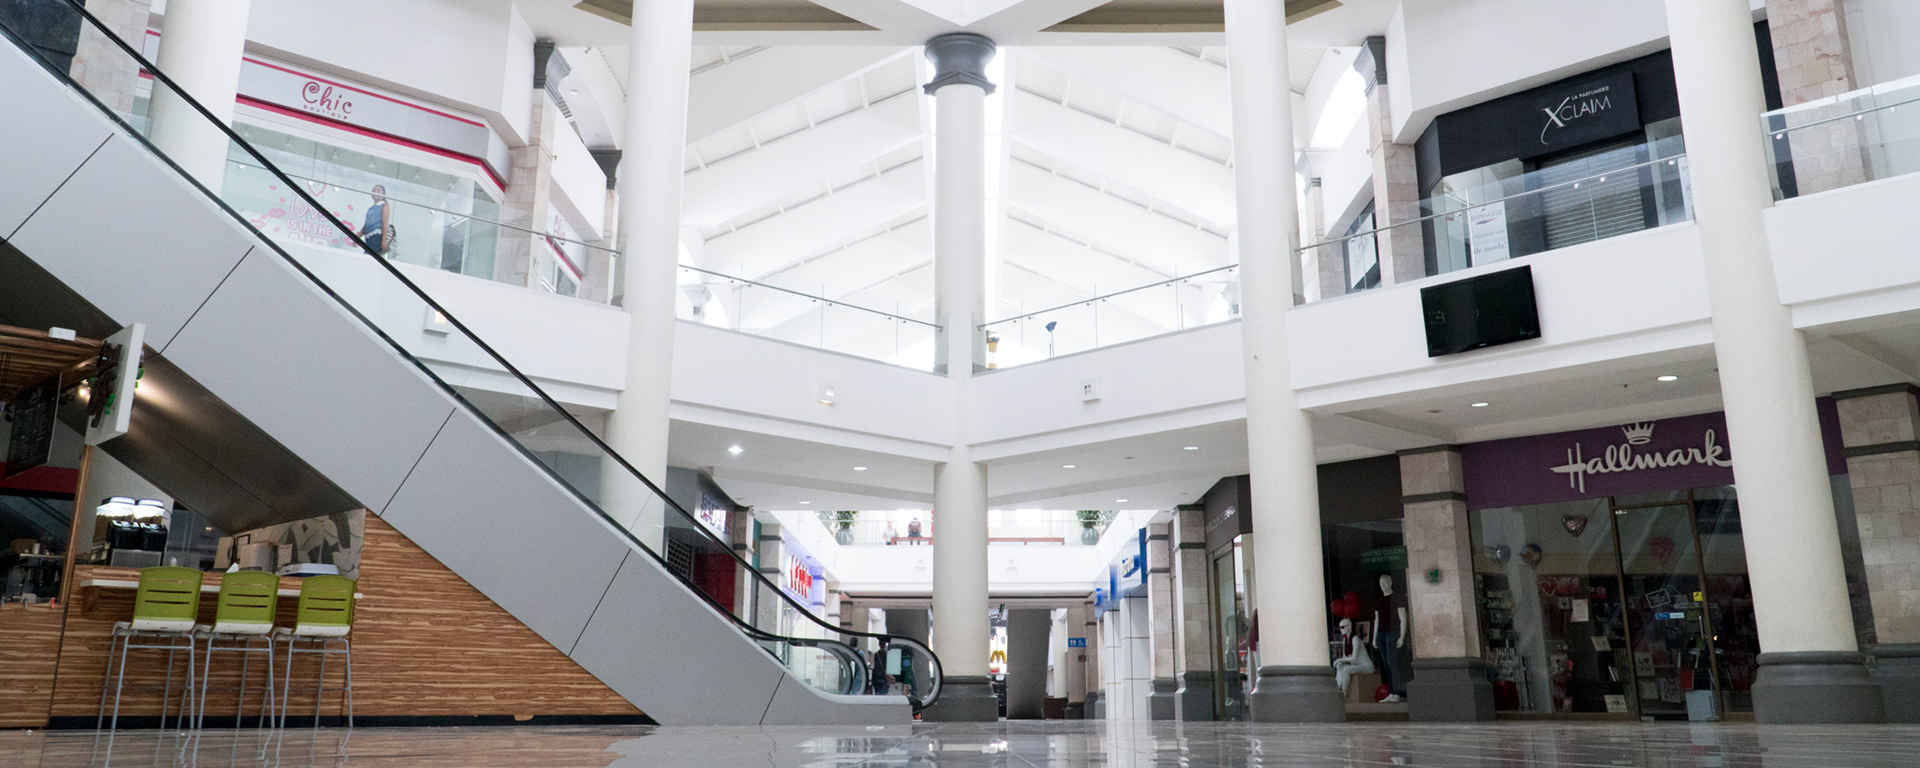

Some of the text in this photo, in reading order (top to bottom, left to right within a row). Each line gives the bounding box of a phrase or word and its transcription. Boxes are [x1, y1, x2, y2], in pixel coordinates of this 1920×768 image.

[302, 81, 352, 114] Chic
[1579, 85, 1610, 98] PARFUMERIE
[1541, 96, 1612, 145] XCLAIM
[286, 218, 334, 238] IS IN THE
[1550, 429, 1732, 494] Hallmark
[1361, 548, 1405, 558] UNITED COLORS
